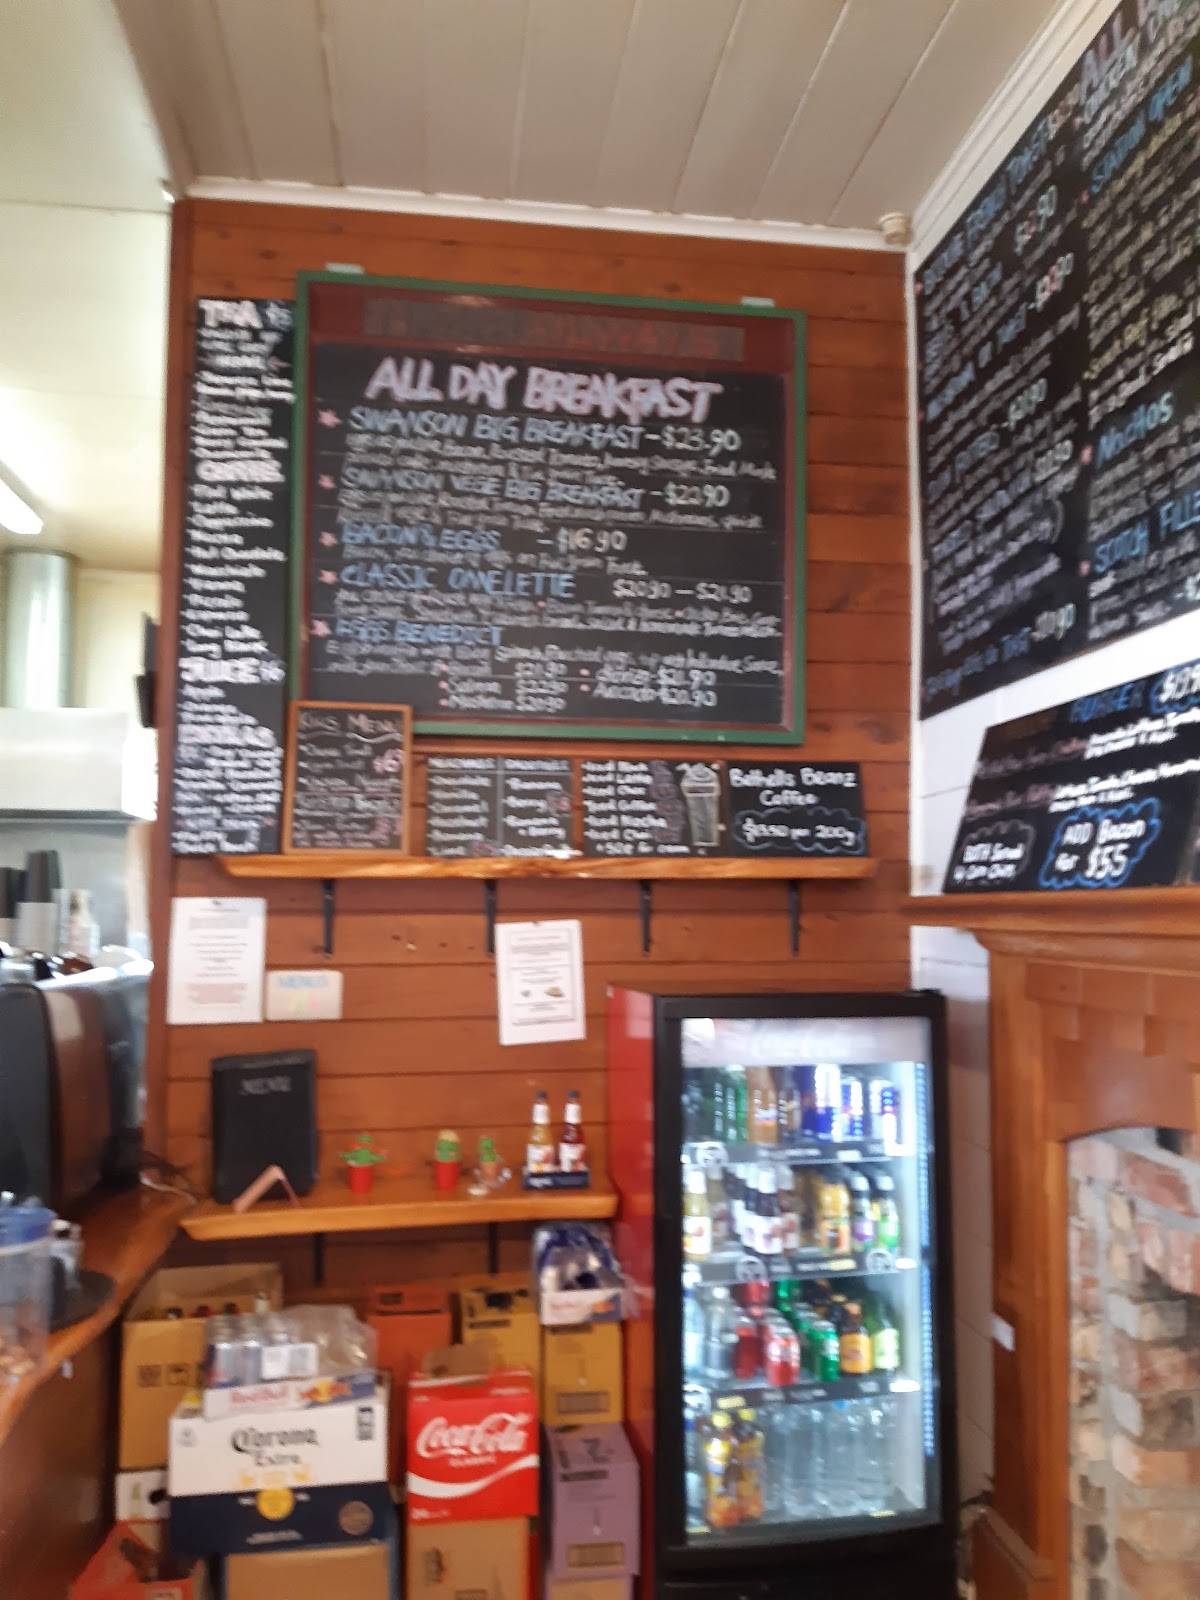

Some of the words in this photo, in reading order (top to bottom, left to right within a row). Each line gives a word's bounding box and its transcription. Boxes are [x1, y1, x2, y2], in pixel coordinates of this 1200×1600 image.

[364, 356, 444, 402] ALL
[448, 360, 517, 410] DAY
[522, 366, 724, 426] BREAKFAST
[472, 413, 520, 443] BIG
[522, 414, 646, 451] BREAKFAST
[339, 562, 438, 590] CLASSIC
[416, 1412, 532, 1459] Coca-Cola
